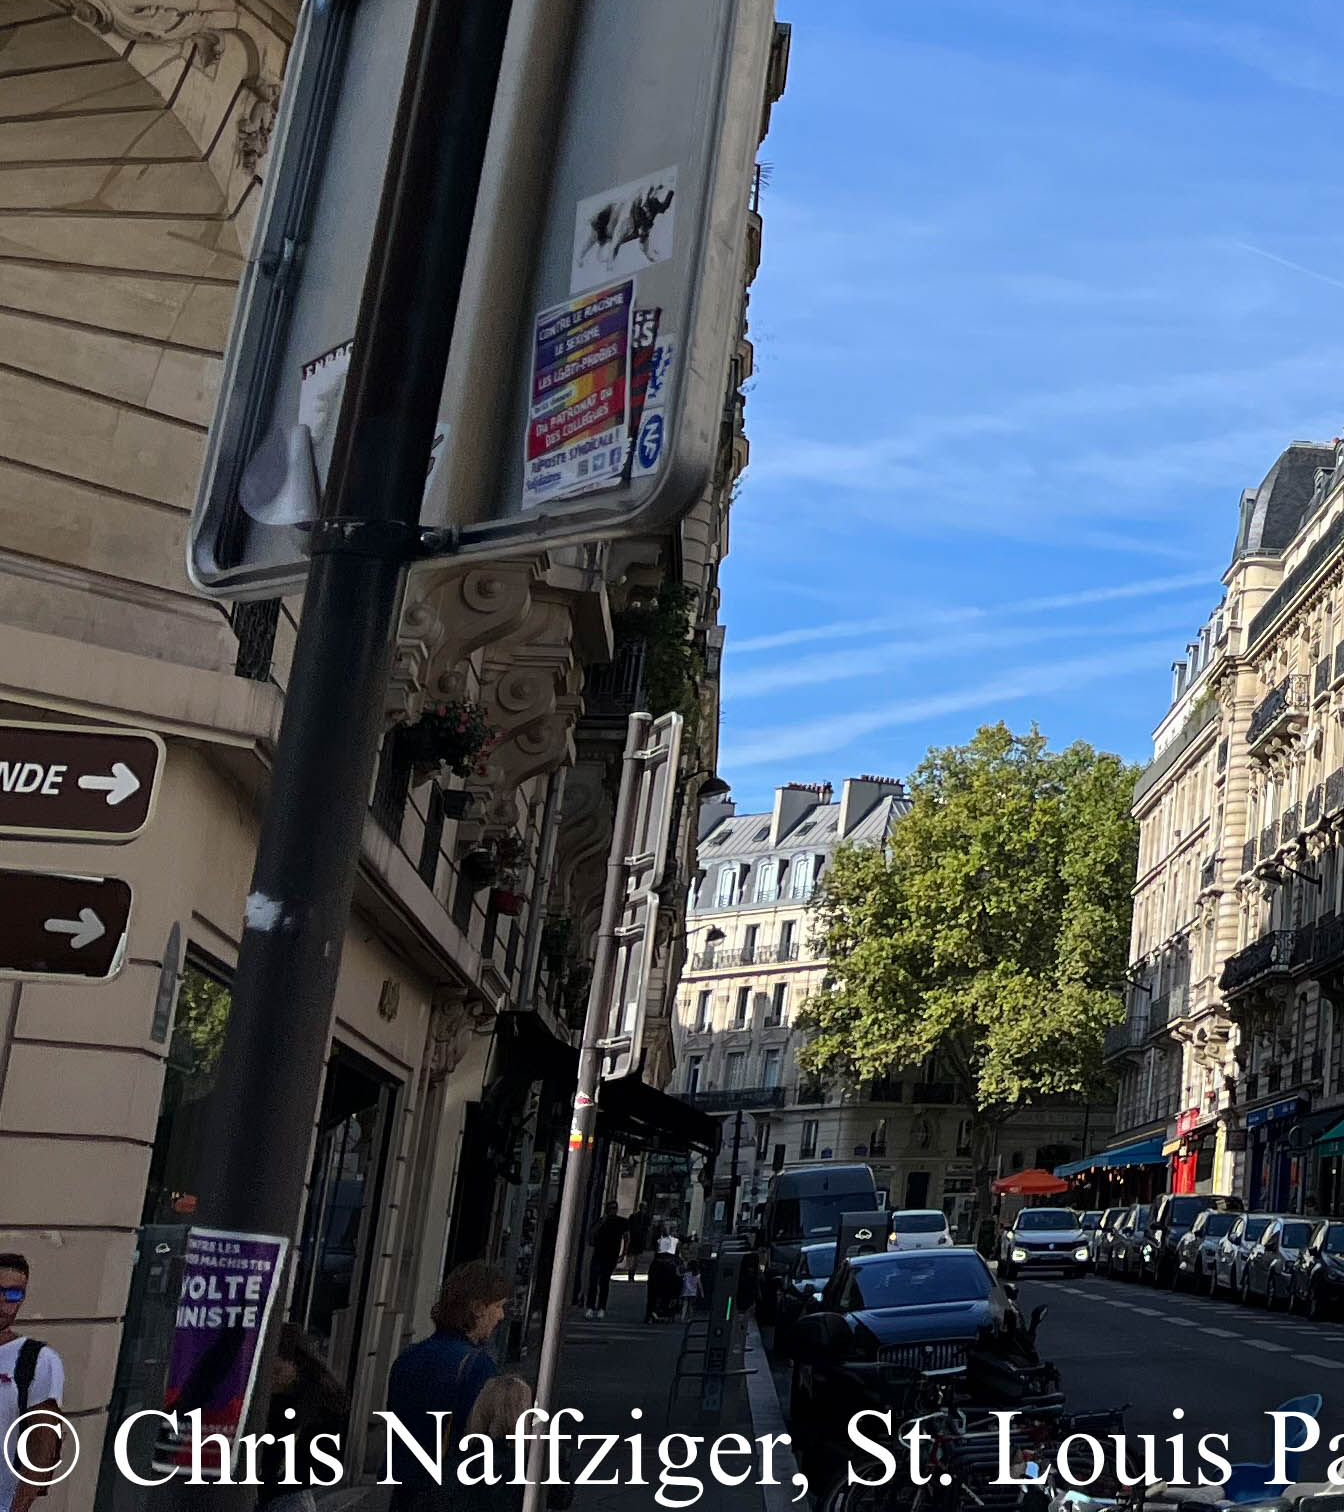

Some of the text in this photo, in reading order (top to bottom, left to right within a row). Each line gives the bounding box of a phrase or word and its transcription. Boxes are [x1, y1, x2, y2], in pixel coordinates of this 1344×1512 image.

[574, 309, 586, 328] LE
[585, 293, 624, 319] RACISME
[555, 343, 565, 356] LE
[538, 374, 553, 390] LES
[550, 393, 598, 428] PATRONAT
